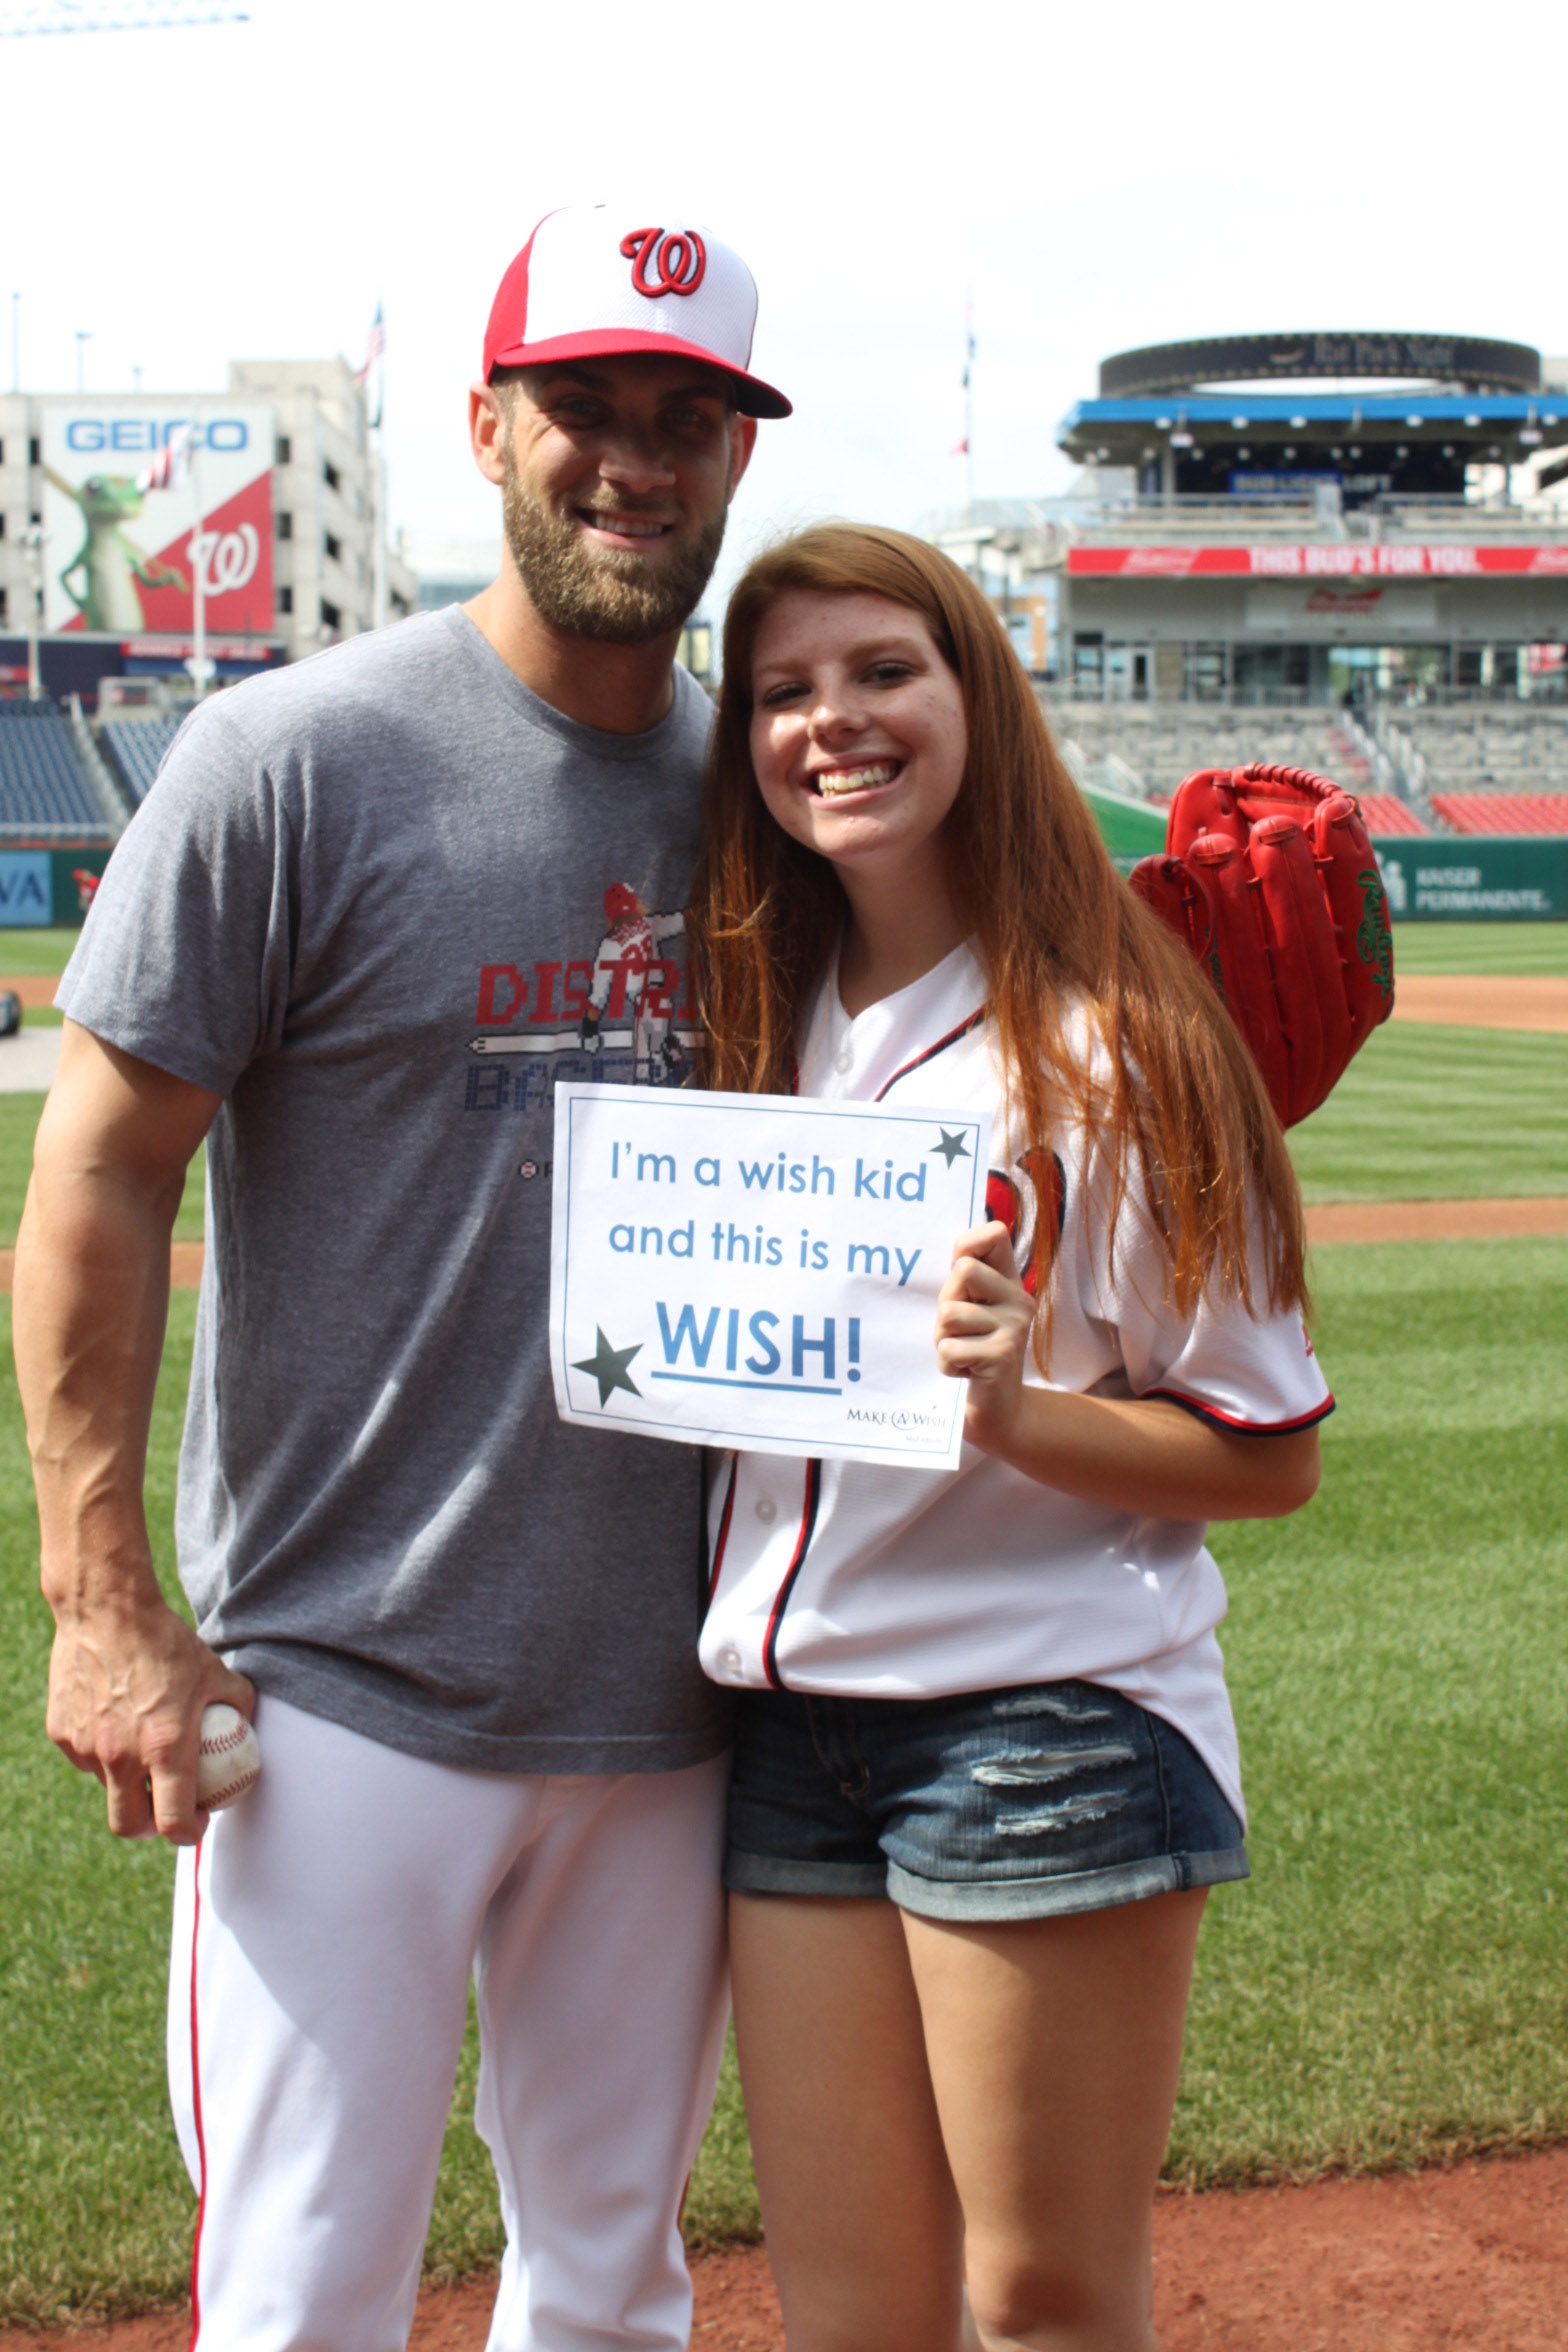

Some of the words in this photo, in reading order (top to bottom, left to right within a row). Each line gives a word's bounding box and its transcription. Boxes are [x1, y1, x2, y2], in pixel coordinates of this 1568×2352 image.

[619, 227, 706, 298] W
[66, 420, 248, 451] GEICO
[1249, 547, 1300, 574] THIS
[1378, 547, 1424, 574] FOR
[1416, 866, 1481, 886] KAISER
[611, 1141, 676, 1183] I'm
[693, 1156, 721, 1187] a
[738, 1152, 835, 1195] wish
[854, 1158, 927, 1202] kid
[608, 1219, 695, 1258] and
[711, 1222, 783, 1266] this
[799, 1230, 829, 1270] is
[847, 1242, 922, 1287] my
[656, 1301, 861, 1383] WISH!
